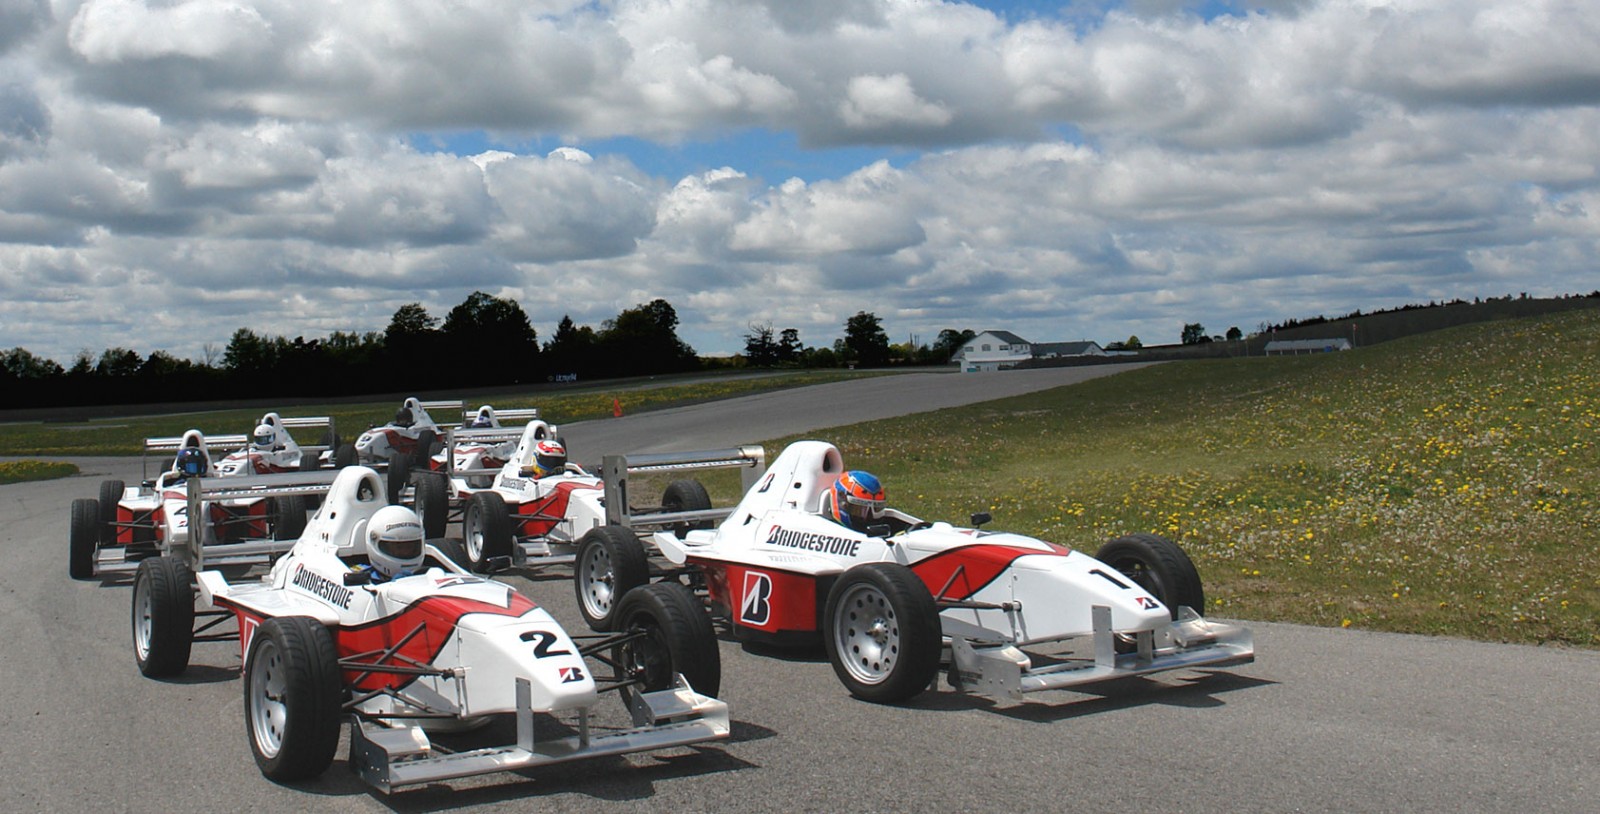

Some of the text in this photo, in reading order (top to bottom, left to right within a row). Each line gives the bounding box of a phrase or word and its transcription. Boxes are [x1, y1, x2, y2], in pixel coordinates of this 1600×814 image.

[766, 524, 862, 557] BRIDGESTONE
[292, 562, 354, 610] BRIDGESTONE
[1088, 568, 1132, 589] 1
[741, 570, 773, 626] B
[519, 629, 573, 659] 2
